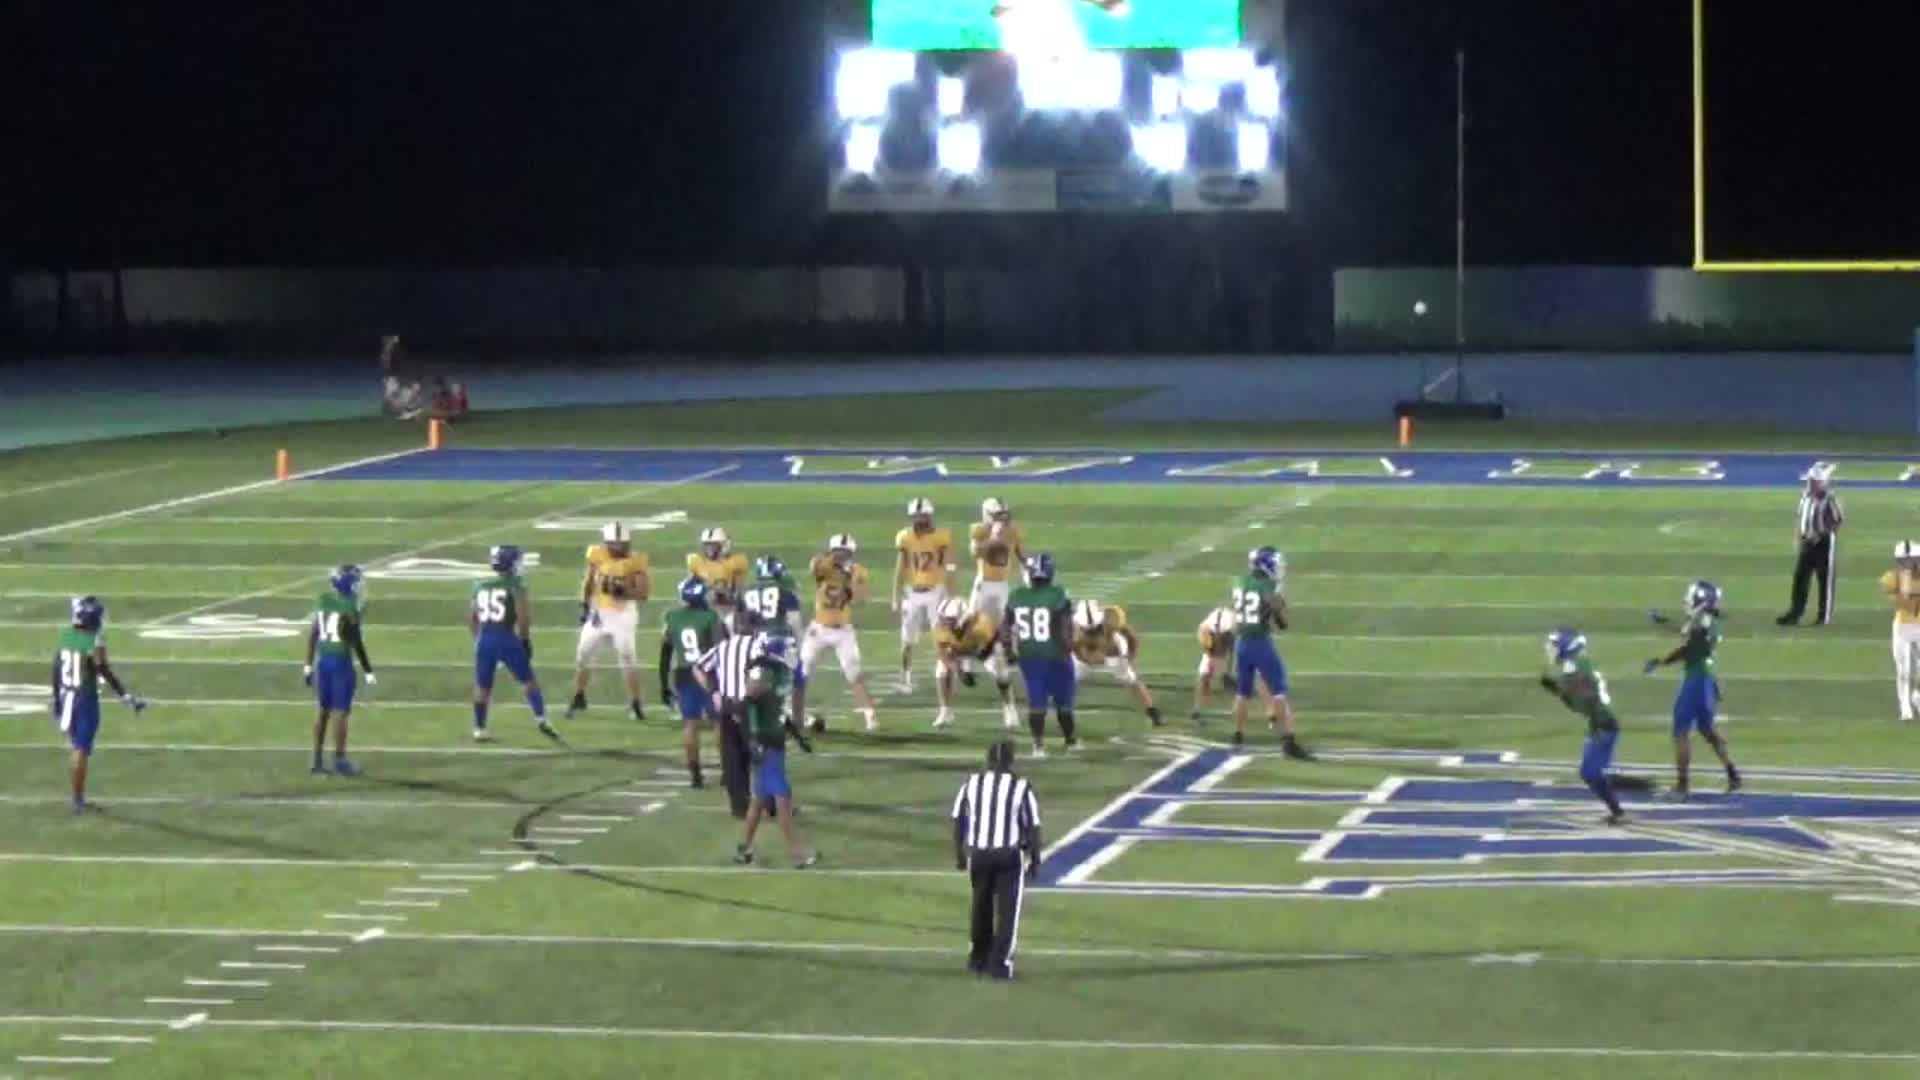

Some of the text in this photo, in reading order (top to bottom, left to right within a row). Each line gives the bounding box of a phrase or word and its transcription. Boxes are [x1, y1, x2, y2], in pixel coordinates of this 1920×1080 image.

[477, 588, 506, 622] 95
[744, 586, 780, 619] 99
[318, 610, 341, 642] 14
[1014, 605, 1050, 642] 58
[681, 628, 701, 662] 9
[60, 649, 81, 687] 21
